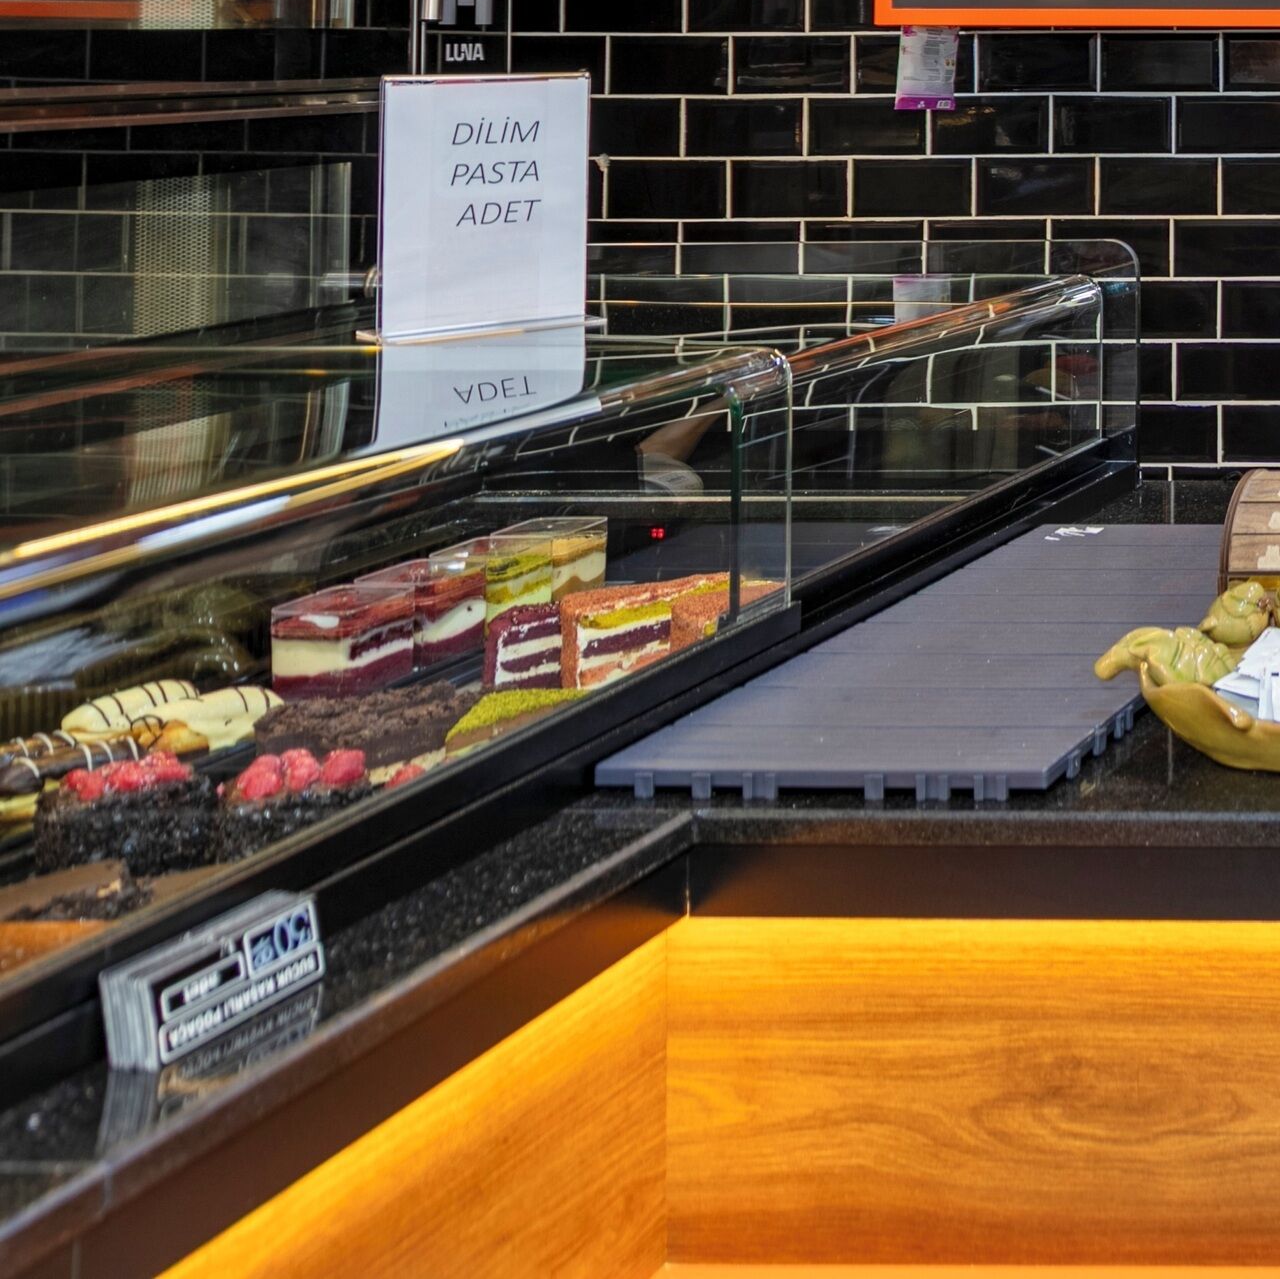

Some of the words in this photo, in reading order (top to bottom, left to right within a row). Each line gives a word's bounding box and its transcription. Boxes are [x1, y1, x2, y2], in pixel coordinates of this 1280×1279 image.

[445, 43, 485, 62] LUNA
[452, 116, 540, 146] DİLİM
[450, 160, 540, 187] PASTA
[456, 199, 542, 228] ADET
